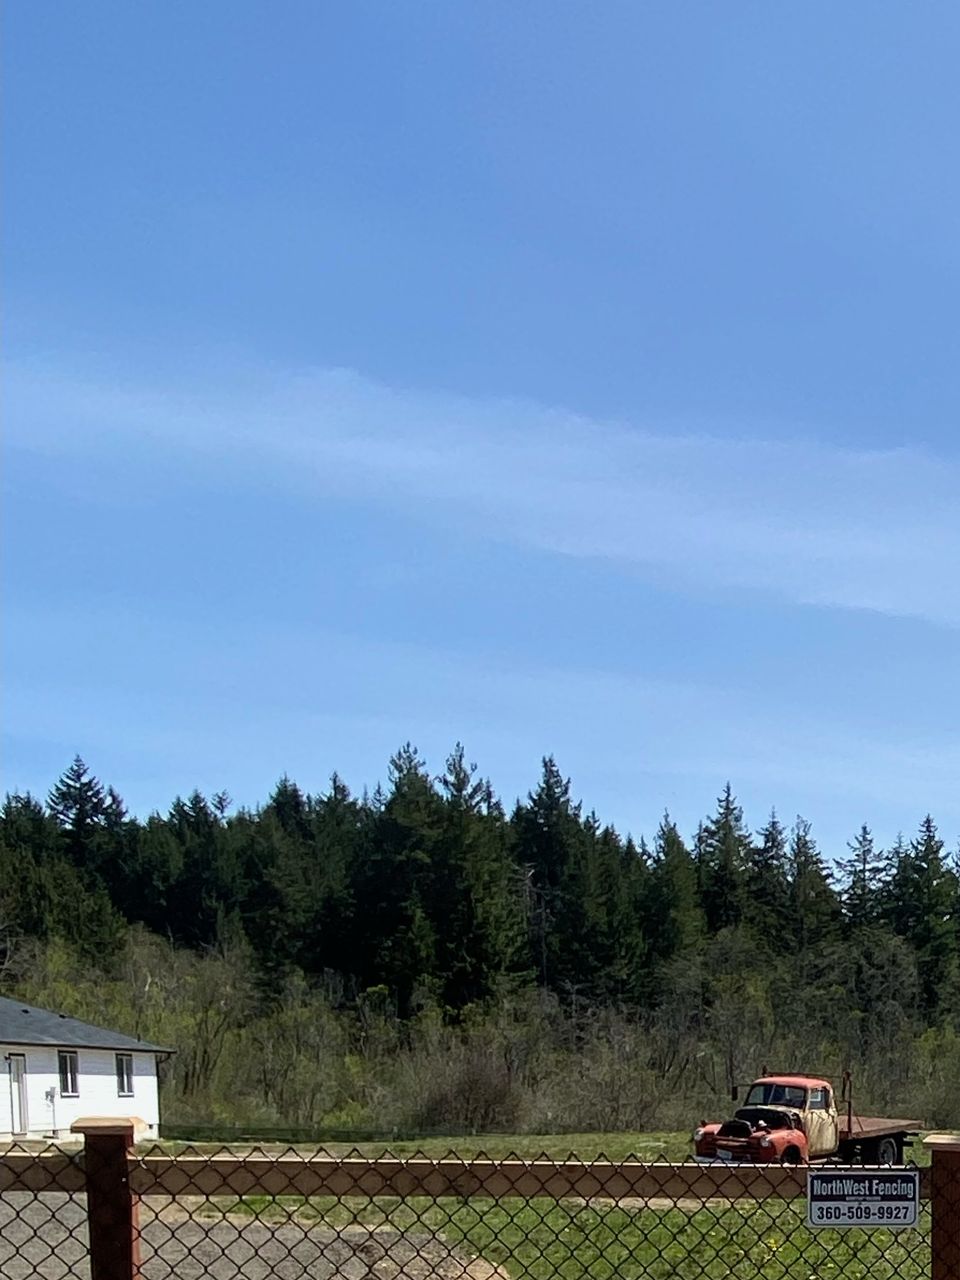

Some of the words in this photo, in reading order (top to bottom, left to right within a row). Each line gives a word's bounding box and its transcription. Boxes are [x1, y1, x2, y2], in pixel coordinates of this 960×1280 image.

[813, 1179, 869, 1195] NorthWest
[872, 1180, 914, 1198] Fencing
[817, 1206, 909, 1220] 360-509-9927
